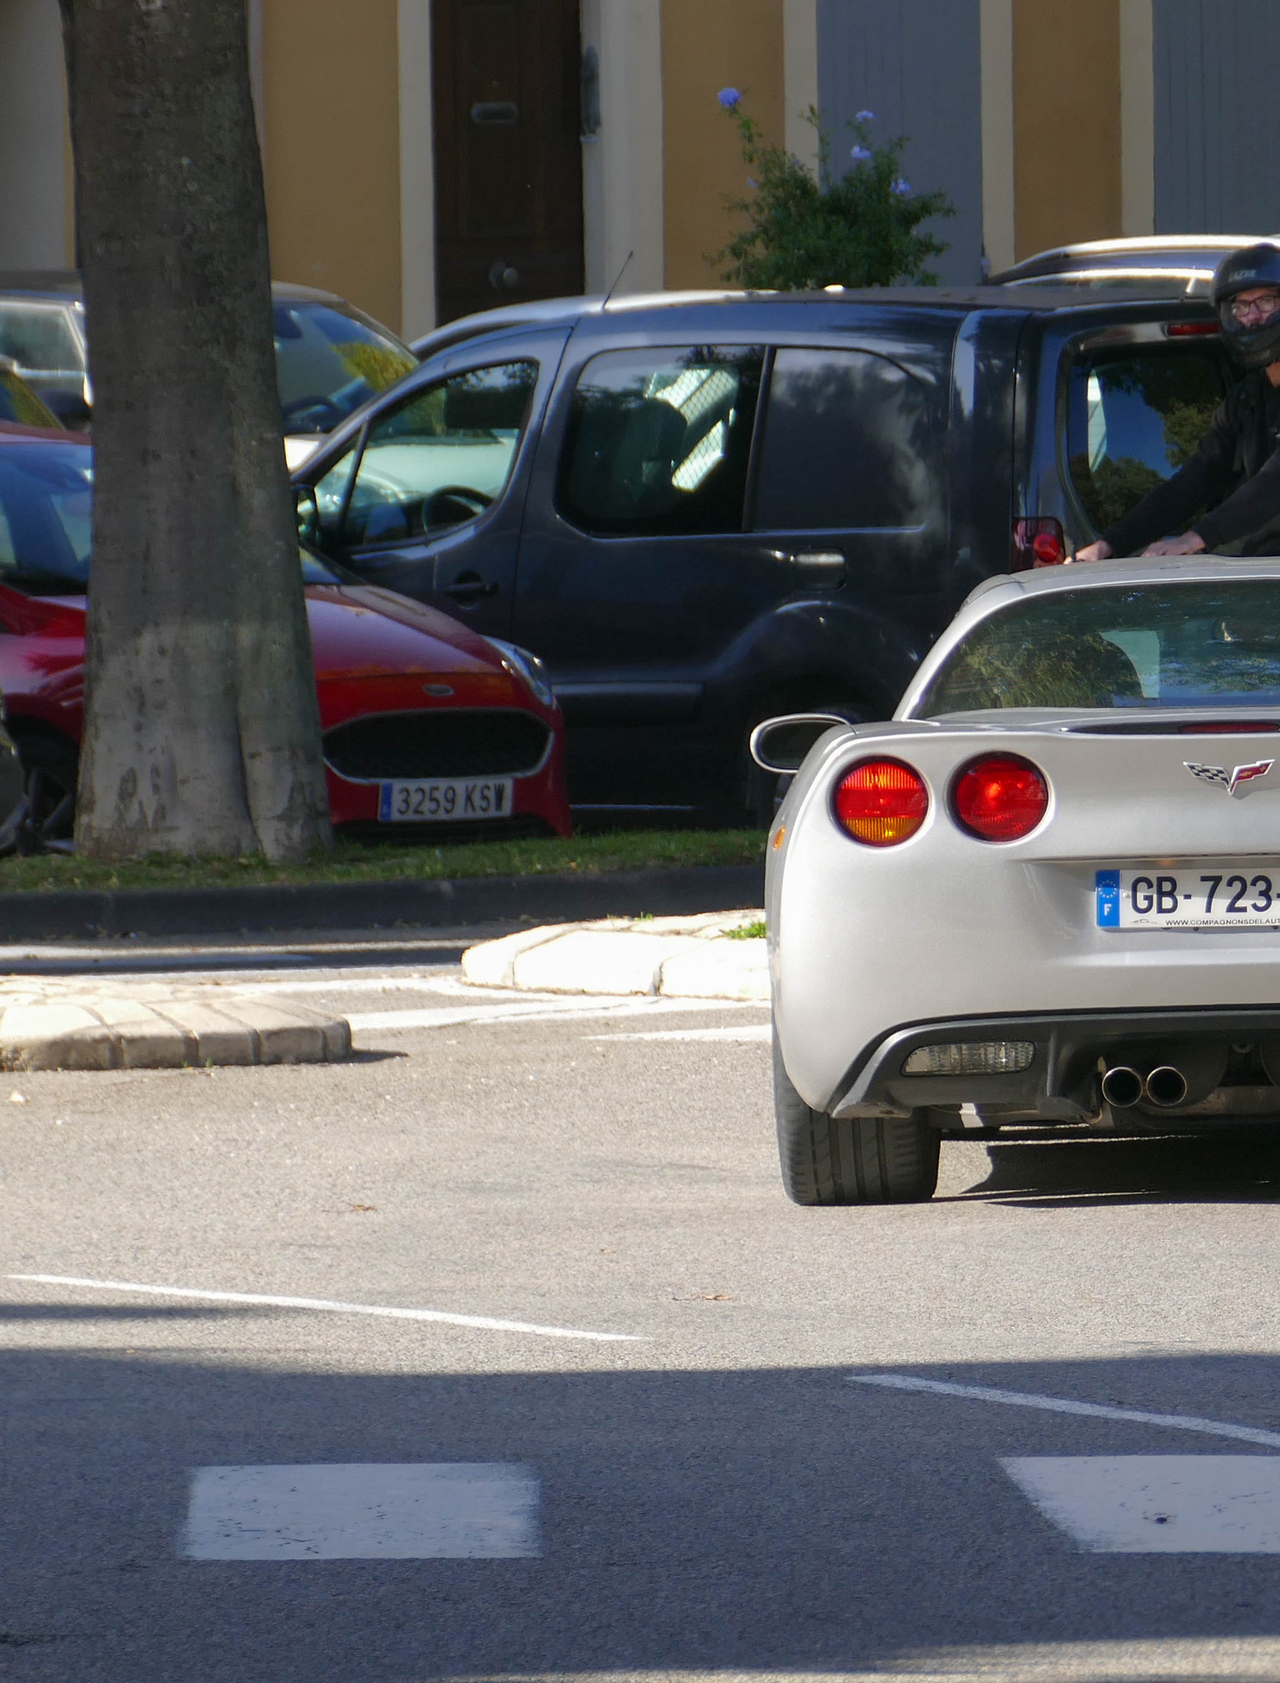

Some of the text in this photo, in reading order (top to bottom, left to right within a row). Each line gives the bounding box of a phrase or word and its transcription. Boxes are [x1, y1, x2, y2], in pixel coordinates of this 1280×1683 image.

[397, 783, 505, 815] 3259 KSW
[1103, 903, 1112, 916] F
